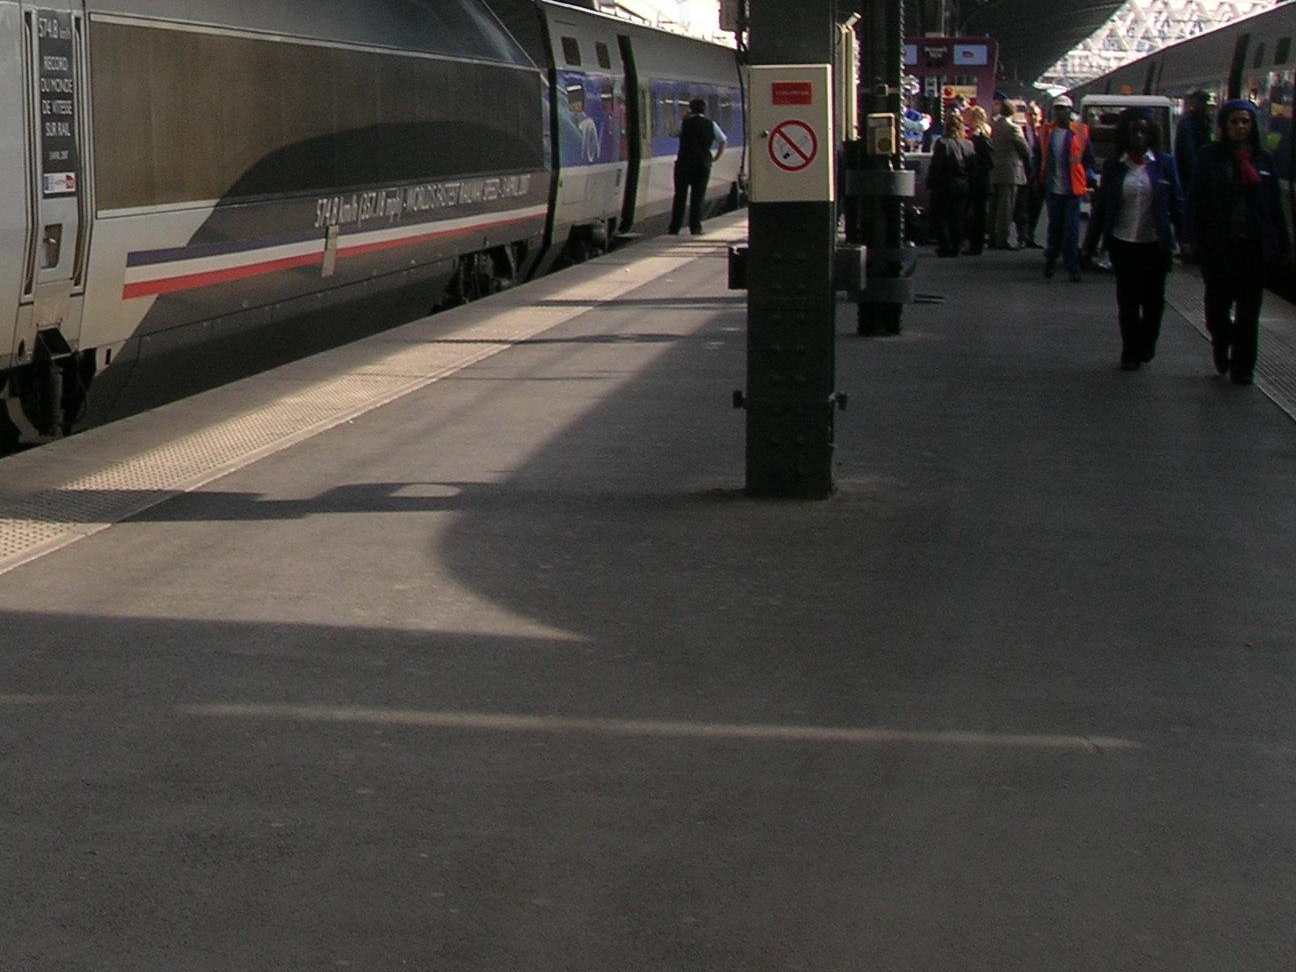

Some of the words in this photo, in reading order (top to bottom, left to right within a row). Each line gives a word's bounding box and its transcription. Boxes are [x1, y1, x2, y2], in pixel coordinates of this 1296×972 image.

[43, 55, 68, 71] RECORD
[41, 77, 50, 93] DU
[51, 78, 73, 93] MONDE
[42, 99, 51, 115] DE
[53, 99, 72, 115] VITESSE
[45, 121, 56, 137] SUR
[57, 122, 71, 137] RAIL
